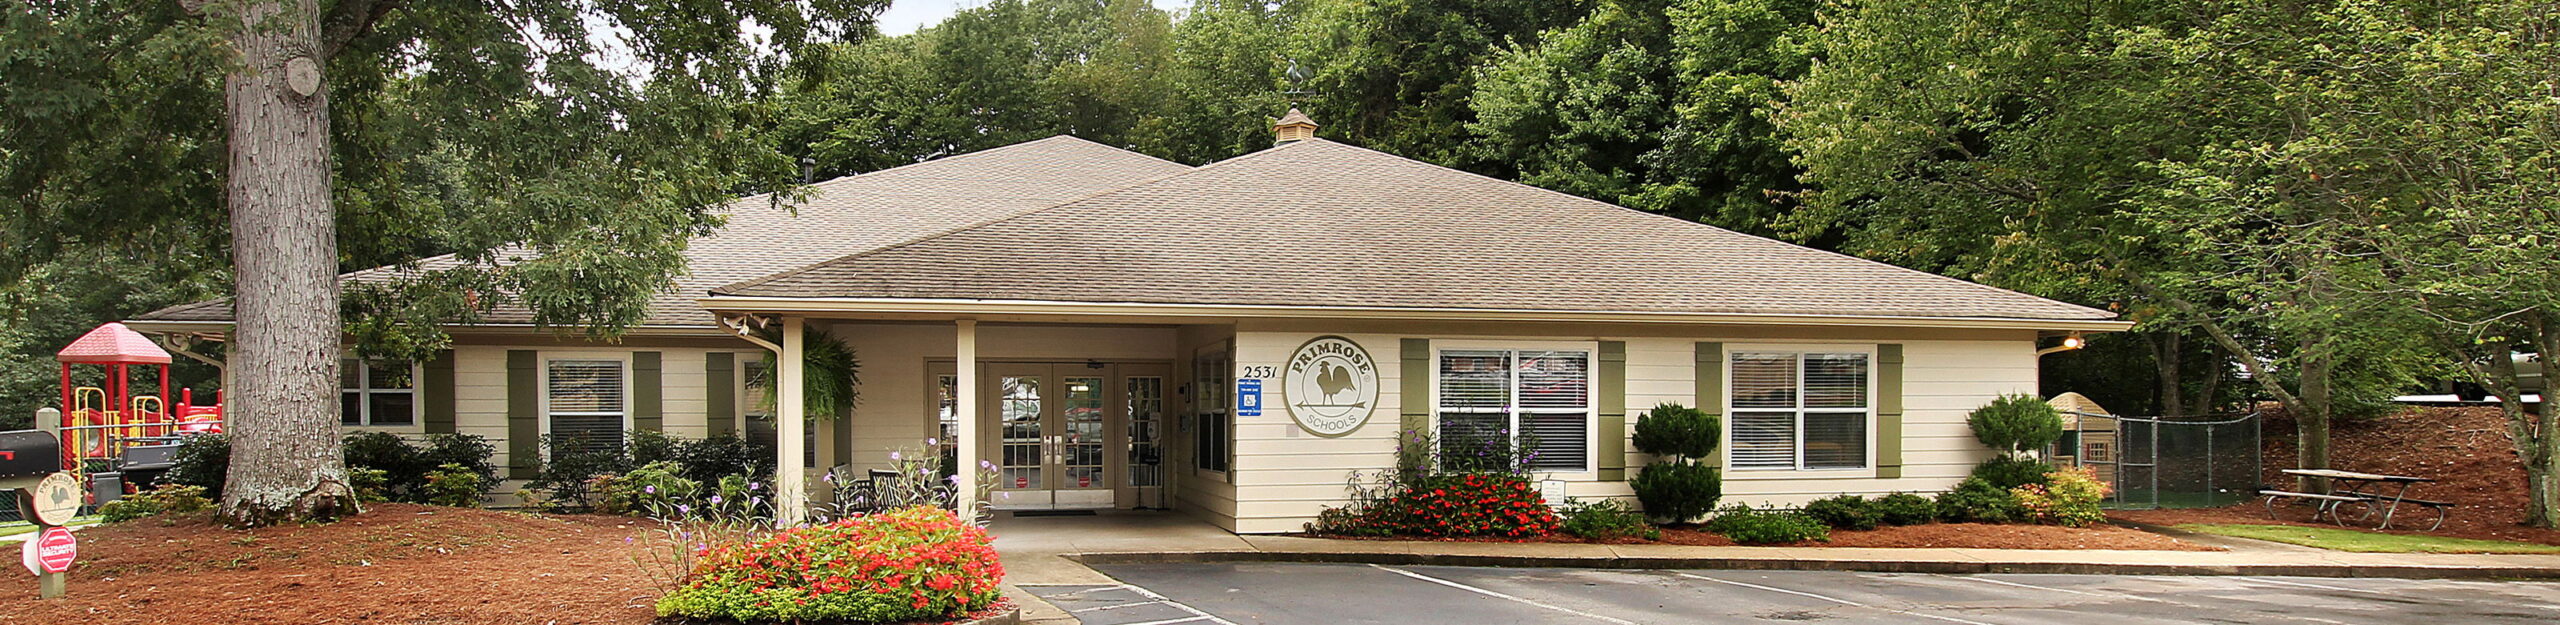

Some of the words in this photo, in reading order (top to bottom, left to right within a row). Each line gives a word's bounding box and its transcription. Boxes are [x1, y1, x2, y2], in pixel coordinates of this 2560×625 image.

[1292, 342, 1370, 375] PRIMROSE
[1244, 366, 1276, 378] 2531
[1306, 414, 1357, 431] SCHOOLS
[39, 475, 77, 494] PRIMROSE
